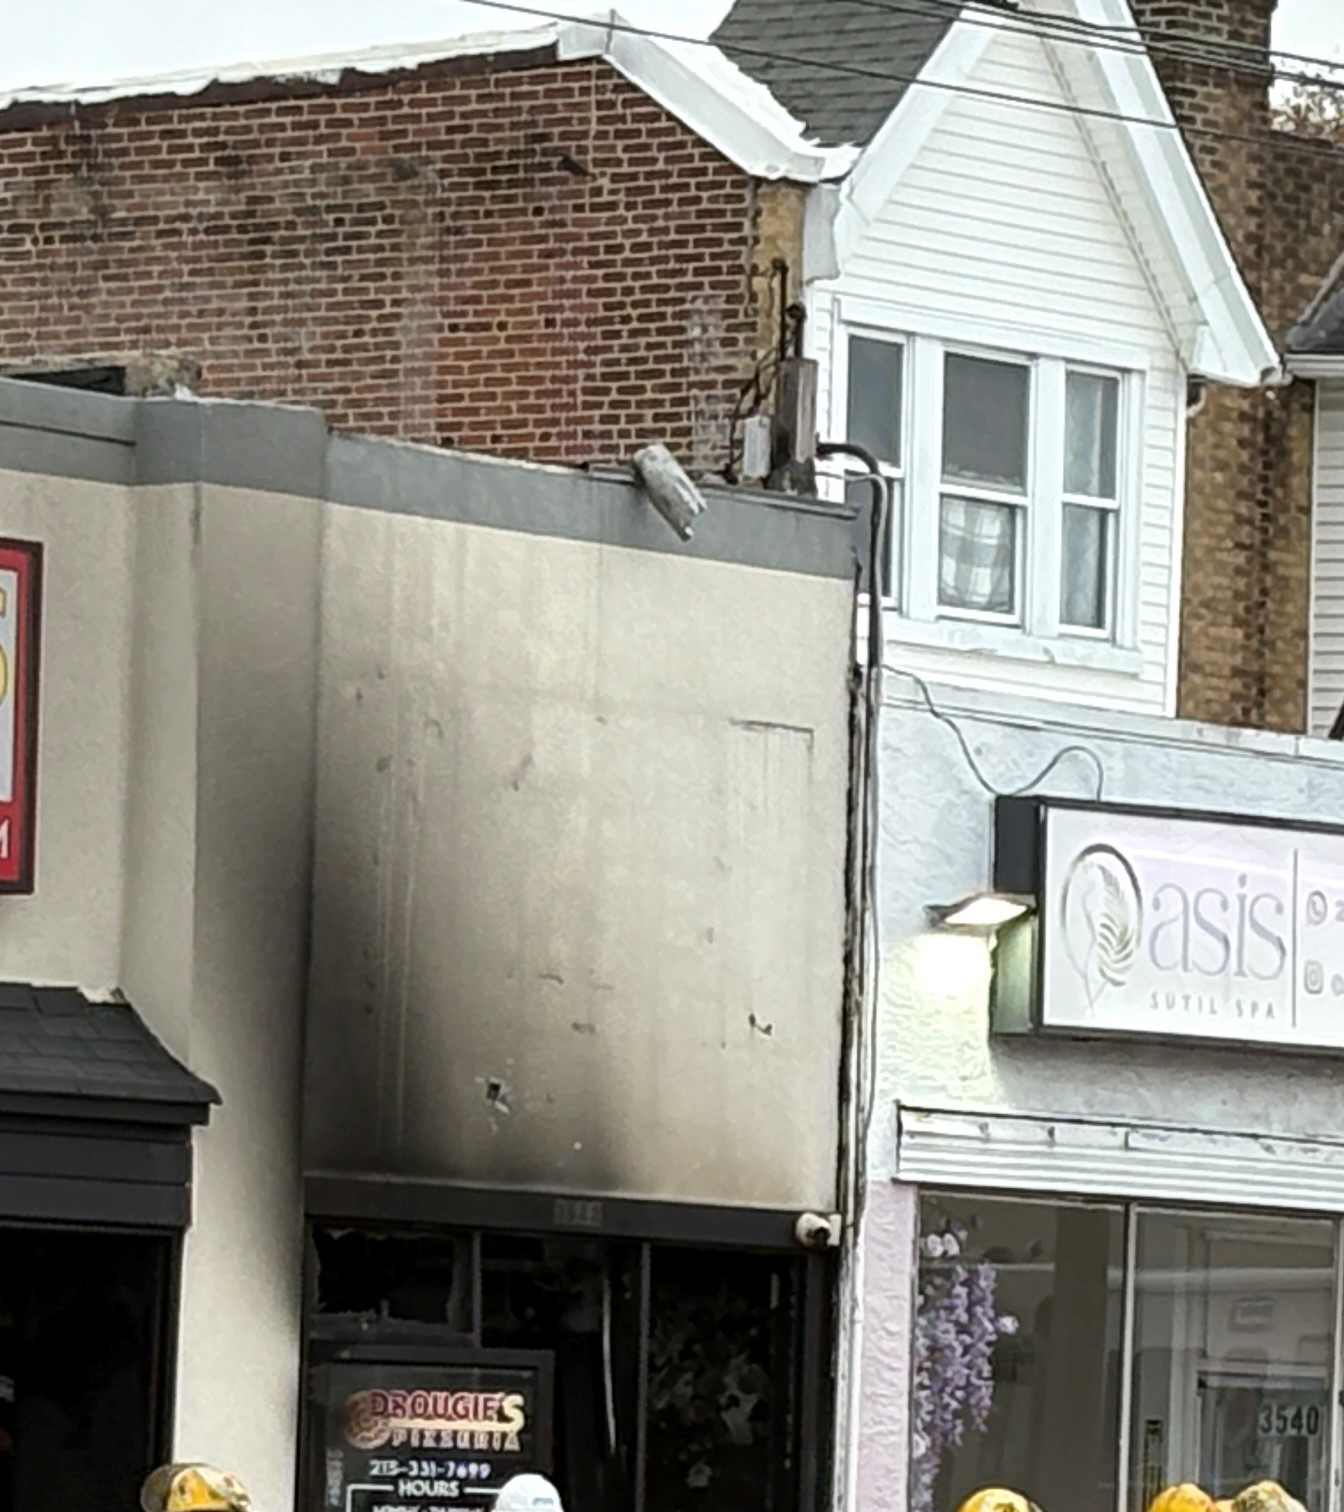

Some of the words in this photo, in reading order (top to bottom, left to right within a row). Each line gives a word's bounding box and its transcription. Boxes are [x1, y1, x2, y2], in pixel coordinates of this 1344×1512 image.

[1235, 998, 1276, 1020] SPA
[1260, 1404, 1319, 1435] 3540
[398, 1480, 459, 1498] HOURS
